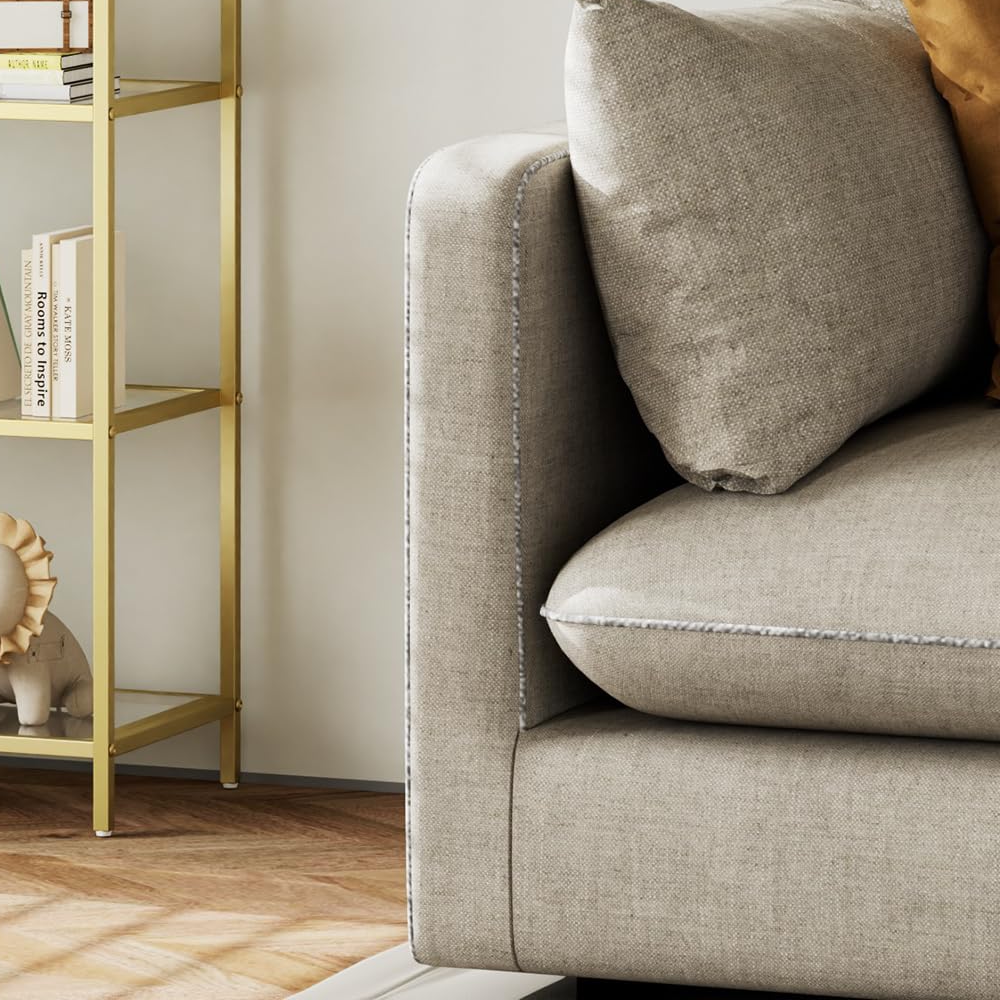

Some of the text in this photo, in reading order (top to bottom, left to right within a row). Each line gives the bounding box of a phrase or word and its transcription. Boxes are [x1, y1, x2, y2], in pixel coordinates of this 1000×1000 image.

[24, 260, 32, 311] MOUNTAIN
[24, 312, 32, 338] GRAY
[34, 291, 48, 407] Rooms to Inspire
[64, 306, 72, 363] KATE MOSS
